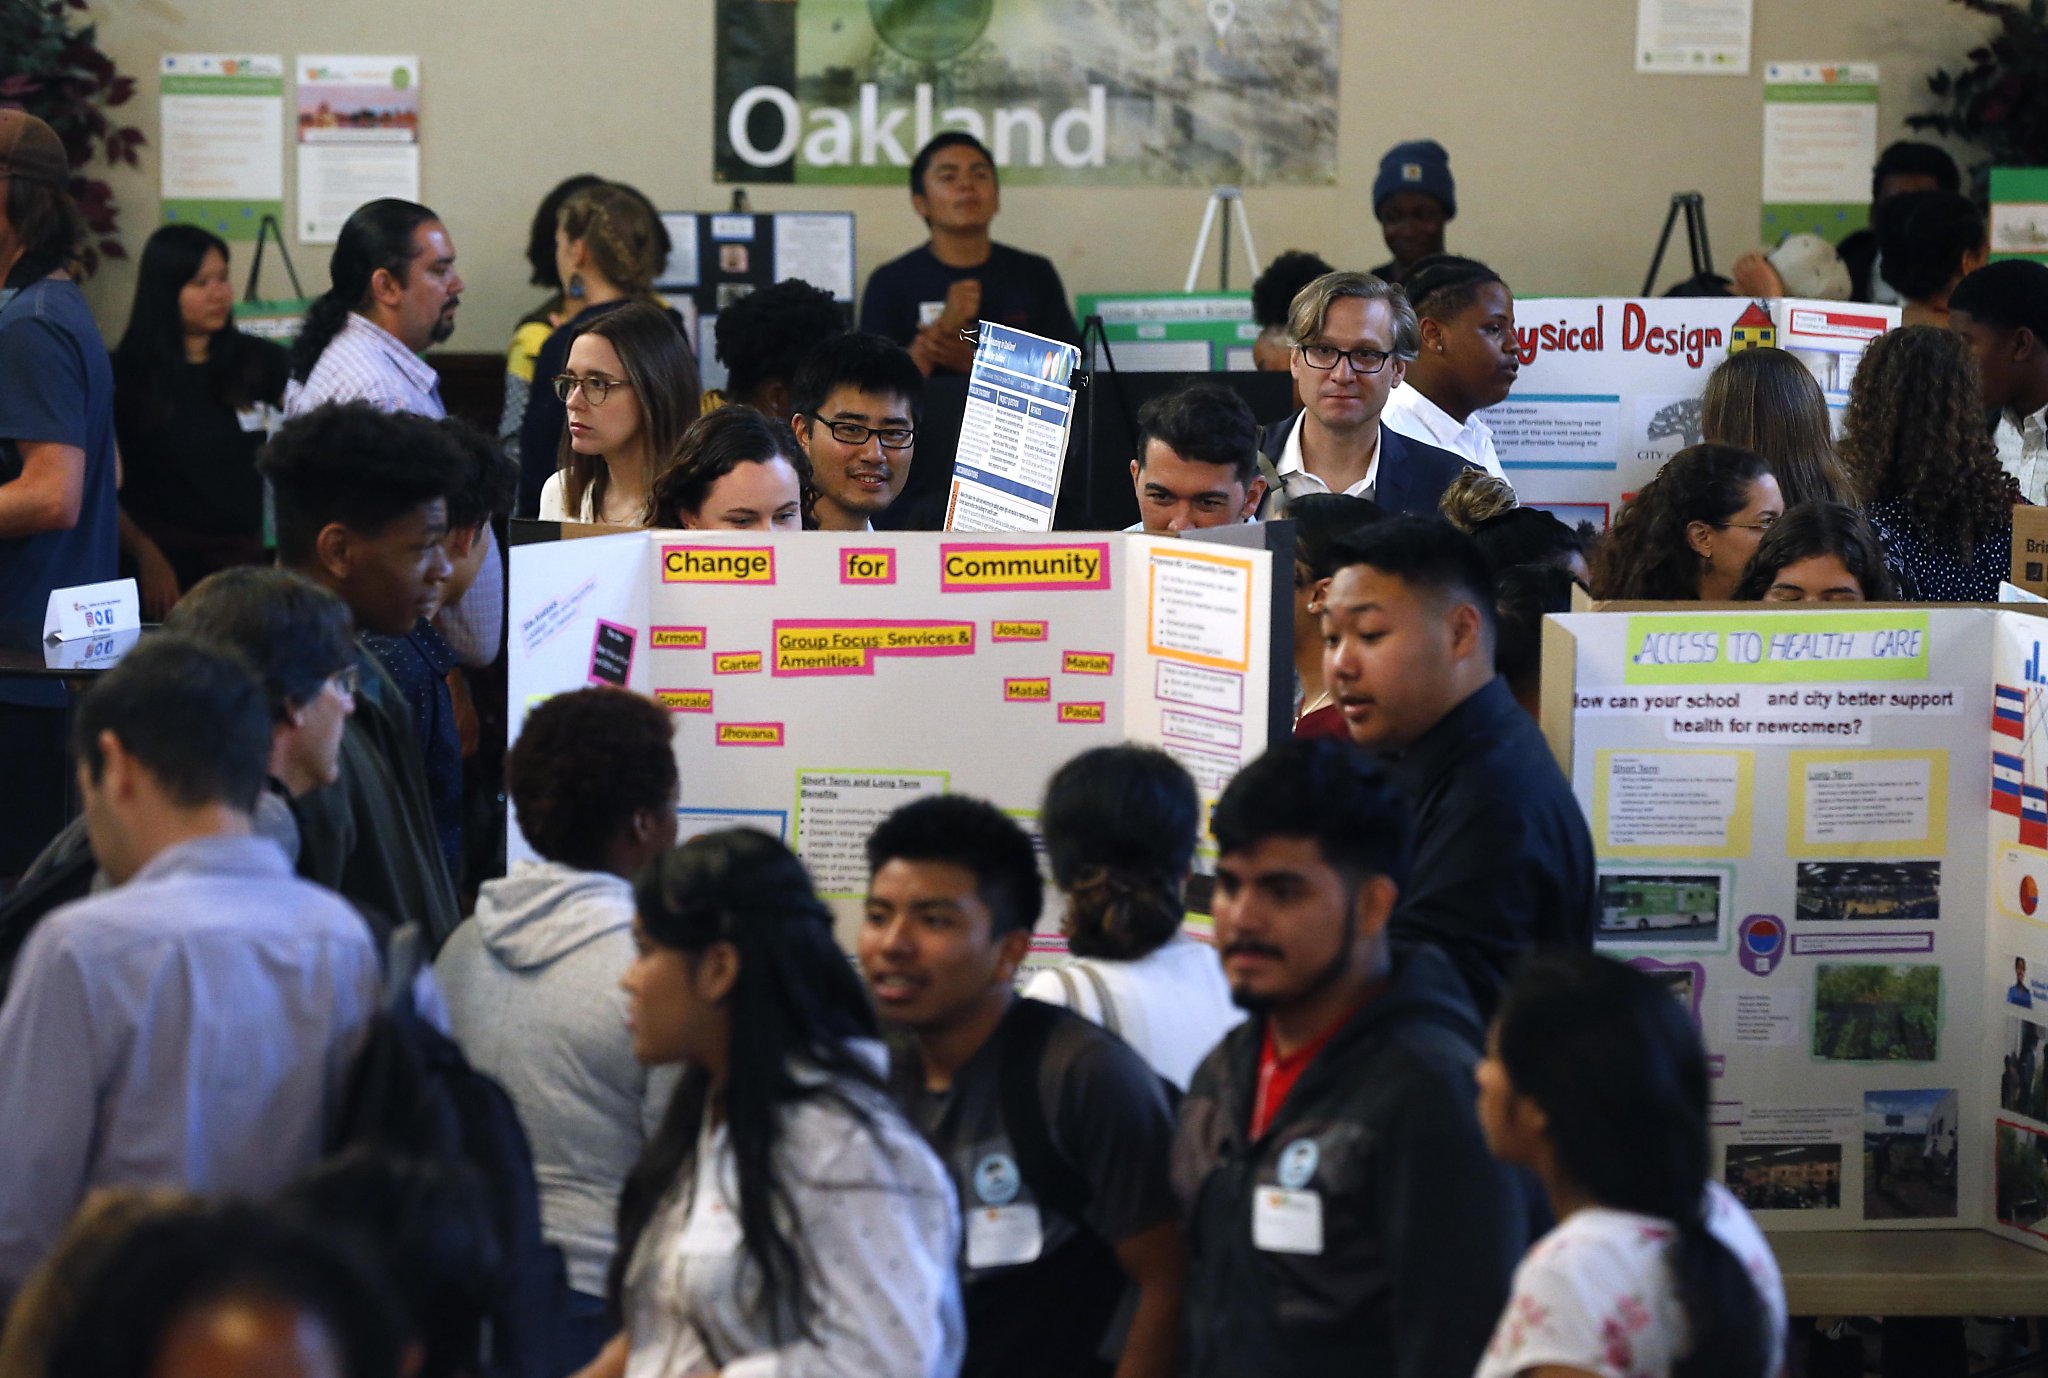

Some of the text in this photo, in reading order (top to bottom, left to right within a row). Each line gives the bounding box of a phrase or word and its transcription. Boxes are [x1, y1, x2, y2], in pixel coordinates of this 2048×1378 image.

[1622, 302, 1722, 368] Design
[1554, 419, 1583, 427] housing
[1557, 440, 1586, 448] housing
[1637, 451, 1662, 460] CITY
[665, 552, 1099, 580] Change for Community
[998, 624, 1042, 636] Joshua
[779, 631, 970, 650] Group Focus: Services &
[1633, 629, 1921, 664] ACCESS TO HEALTH CARE
[719, 659, 759, 671] Carter
[779, 655, 860, 669] Amenities
[1067, 657, 1110, 669] Mariah
[1609, 695, 1639, 709] can
[1644, 695, 1682, 711] your
[1687, 693, 1740, 709] school
[1768, 691, 1798, 706] and
[1804, 691, 1832, 709] city
[1837, 691, 1889, 706] better
[1890, 692, 1954, 709] support
[1065, 706, 1101, 718] Paola
[1673, 718, 1863, 735] health for newcomers?
[801, 776, 921, 789] Short Term and Long Term
[801, 790, 838, 799] Benefits
